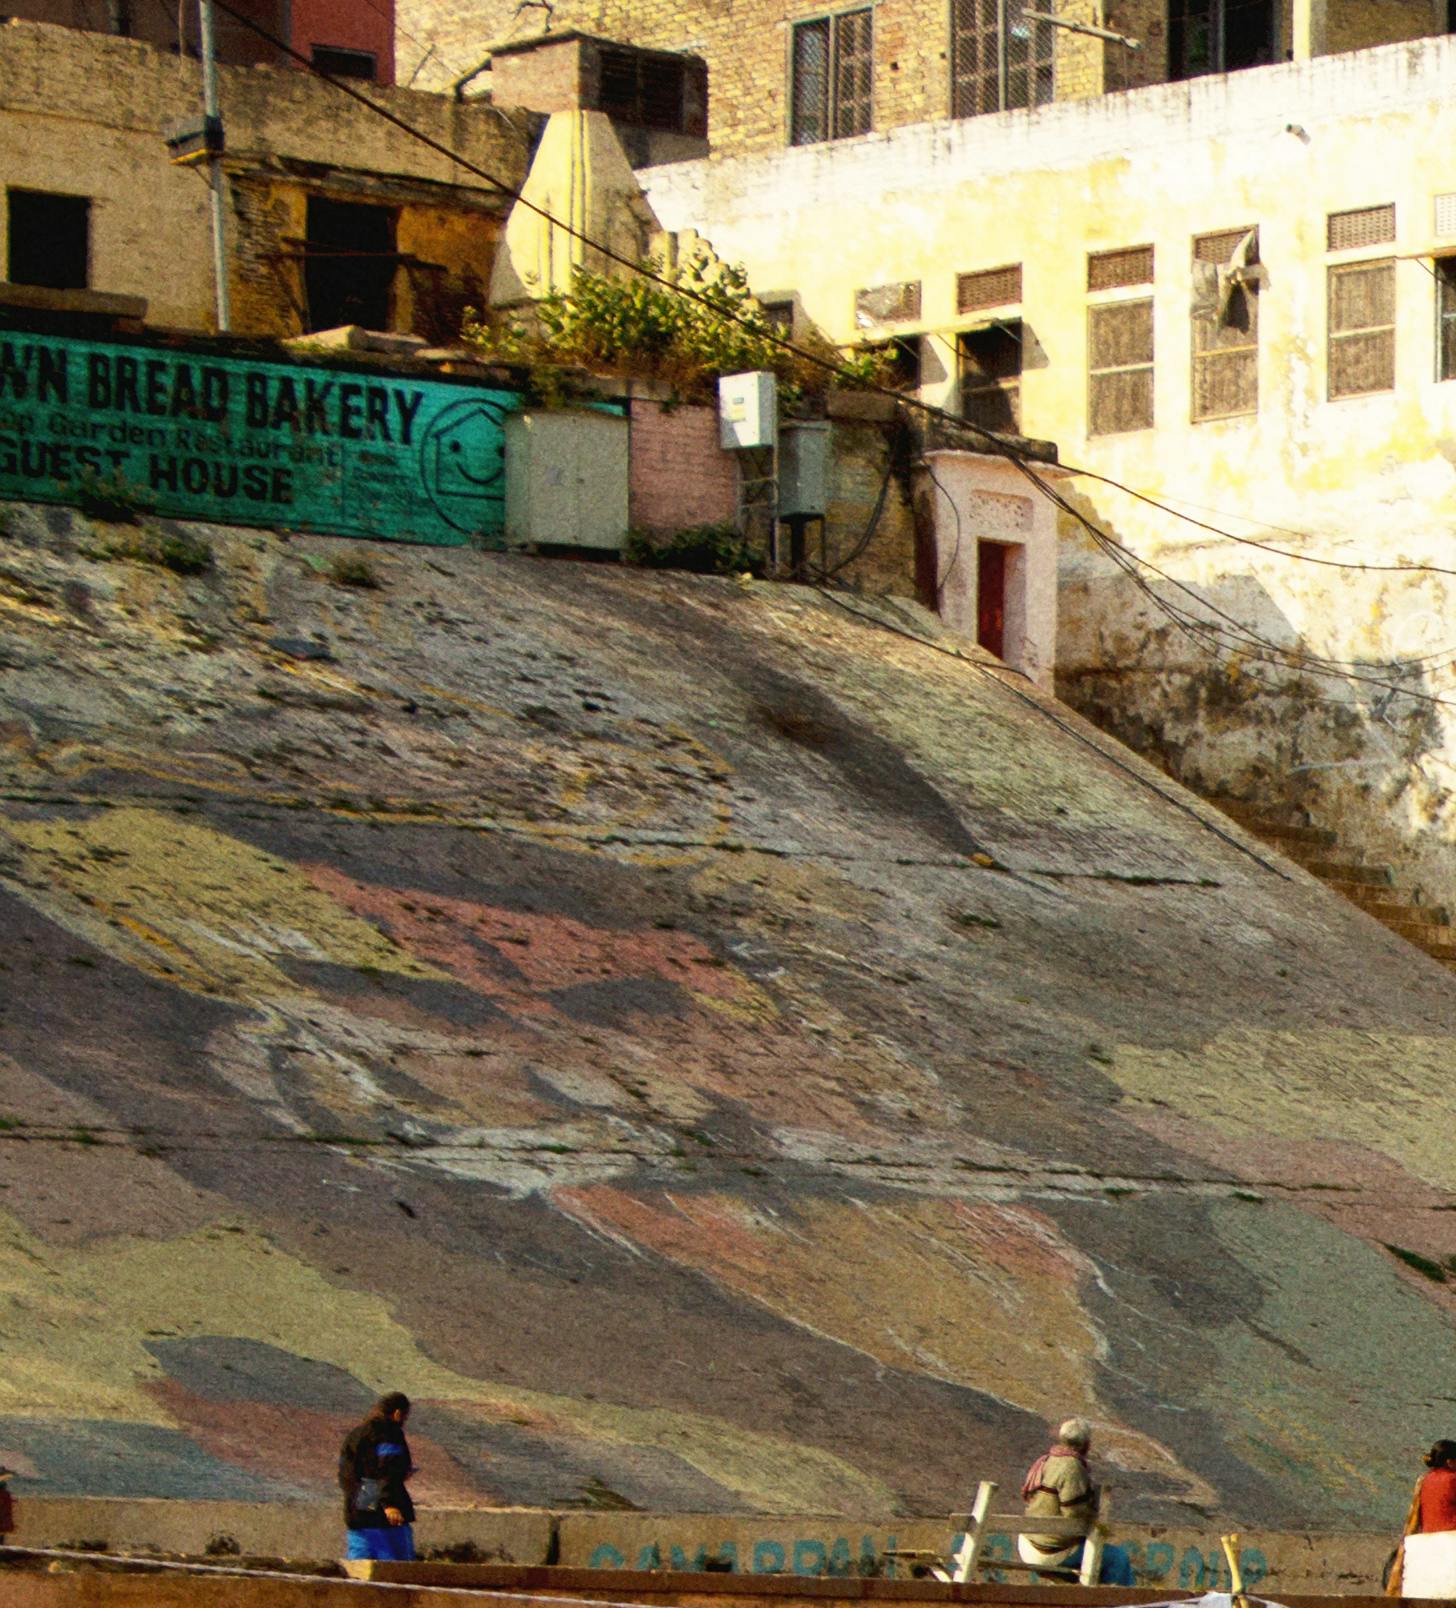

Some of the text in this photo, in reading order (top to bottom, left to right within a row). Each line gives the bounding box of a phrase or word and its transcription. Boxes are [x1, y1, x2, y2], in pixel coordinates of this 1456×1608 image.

[89, 352, 229, 422] BREAD
[247, 372, 424, 446] BAKERY
[49, 412, 167, 448] Garden
[150, 452, 294, 504] HOUSE
